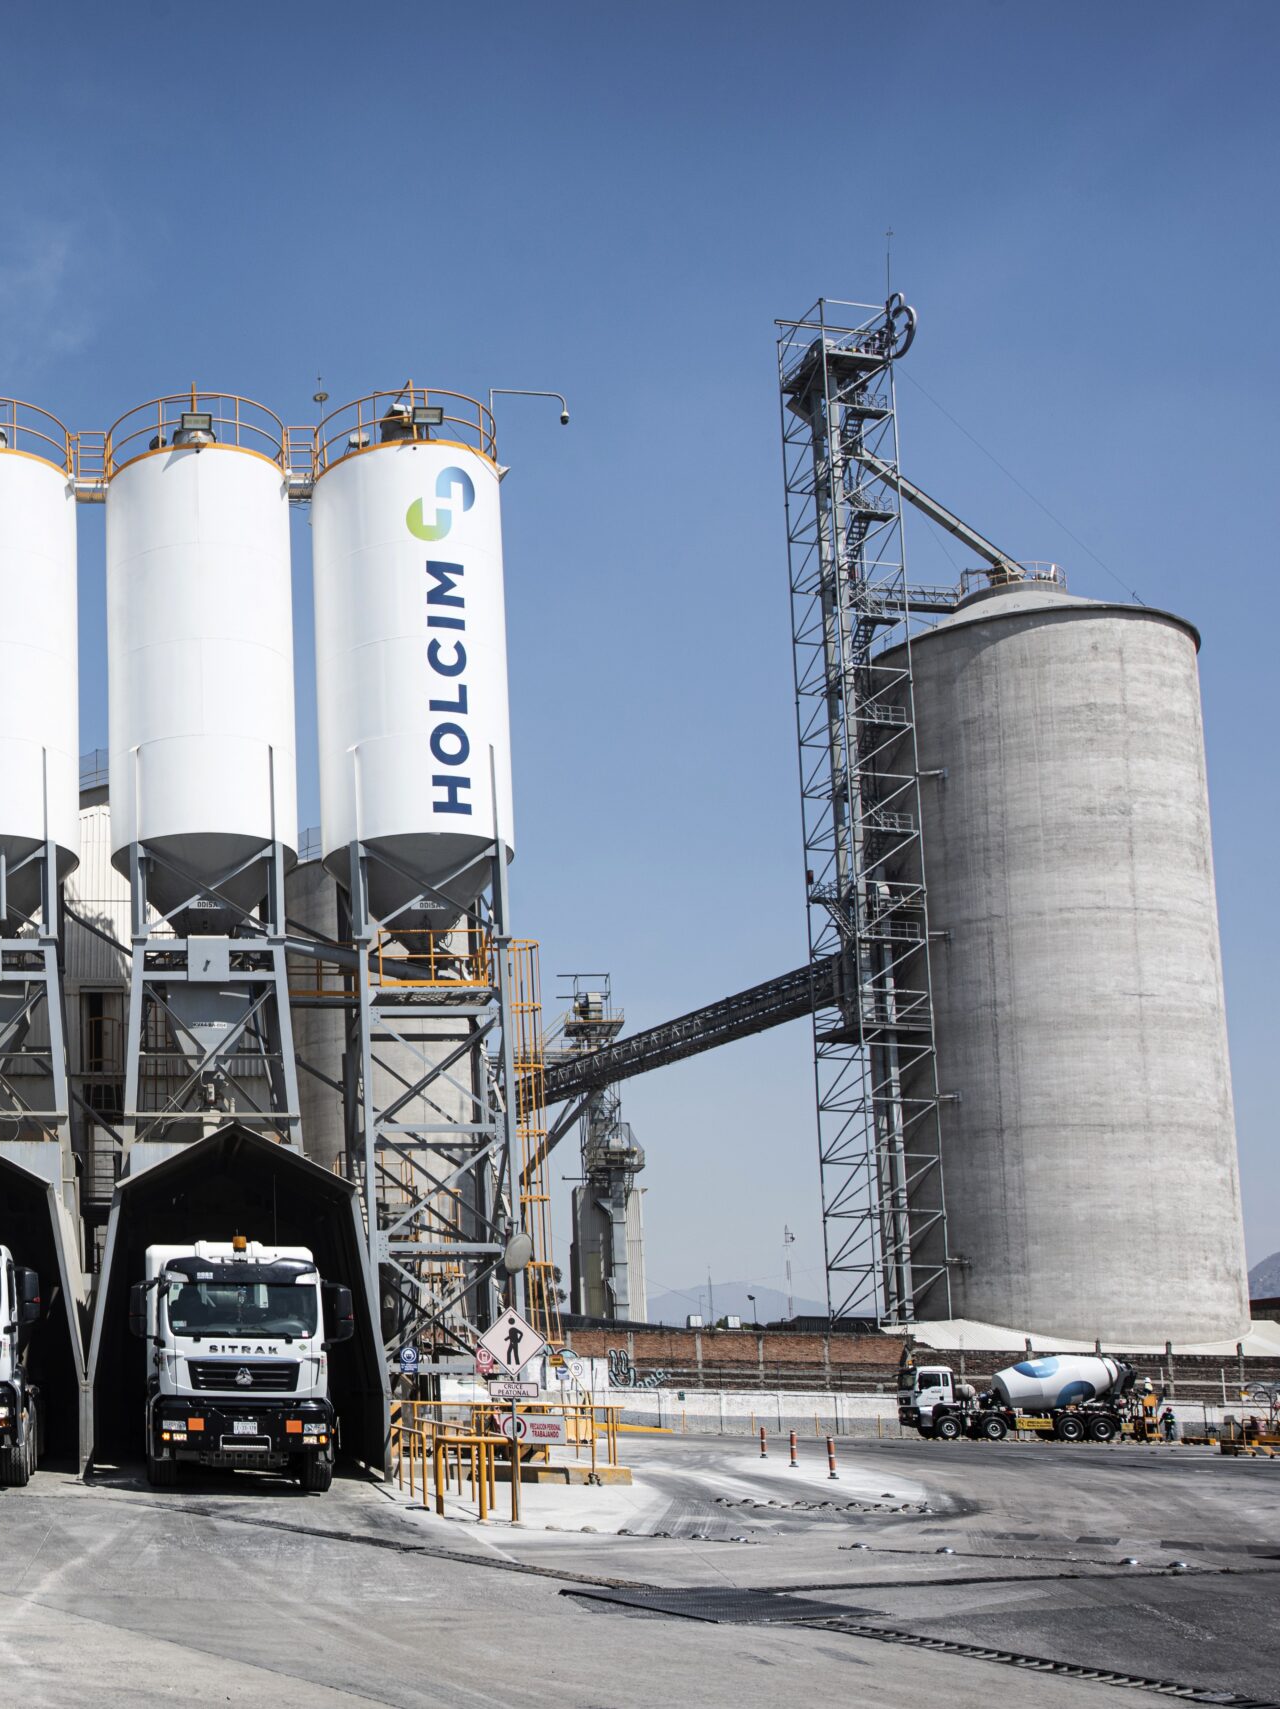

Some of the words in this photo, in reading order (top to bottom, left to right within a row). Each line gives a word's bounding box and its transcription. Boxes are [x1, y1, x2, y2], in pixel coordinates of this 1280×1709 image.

[427, 561, 472, 816] HOLCIM
[209, 1345, 278, 1354] SITRAK
[532, 1430, 560, 1438] TRABAJANDO
